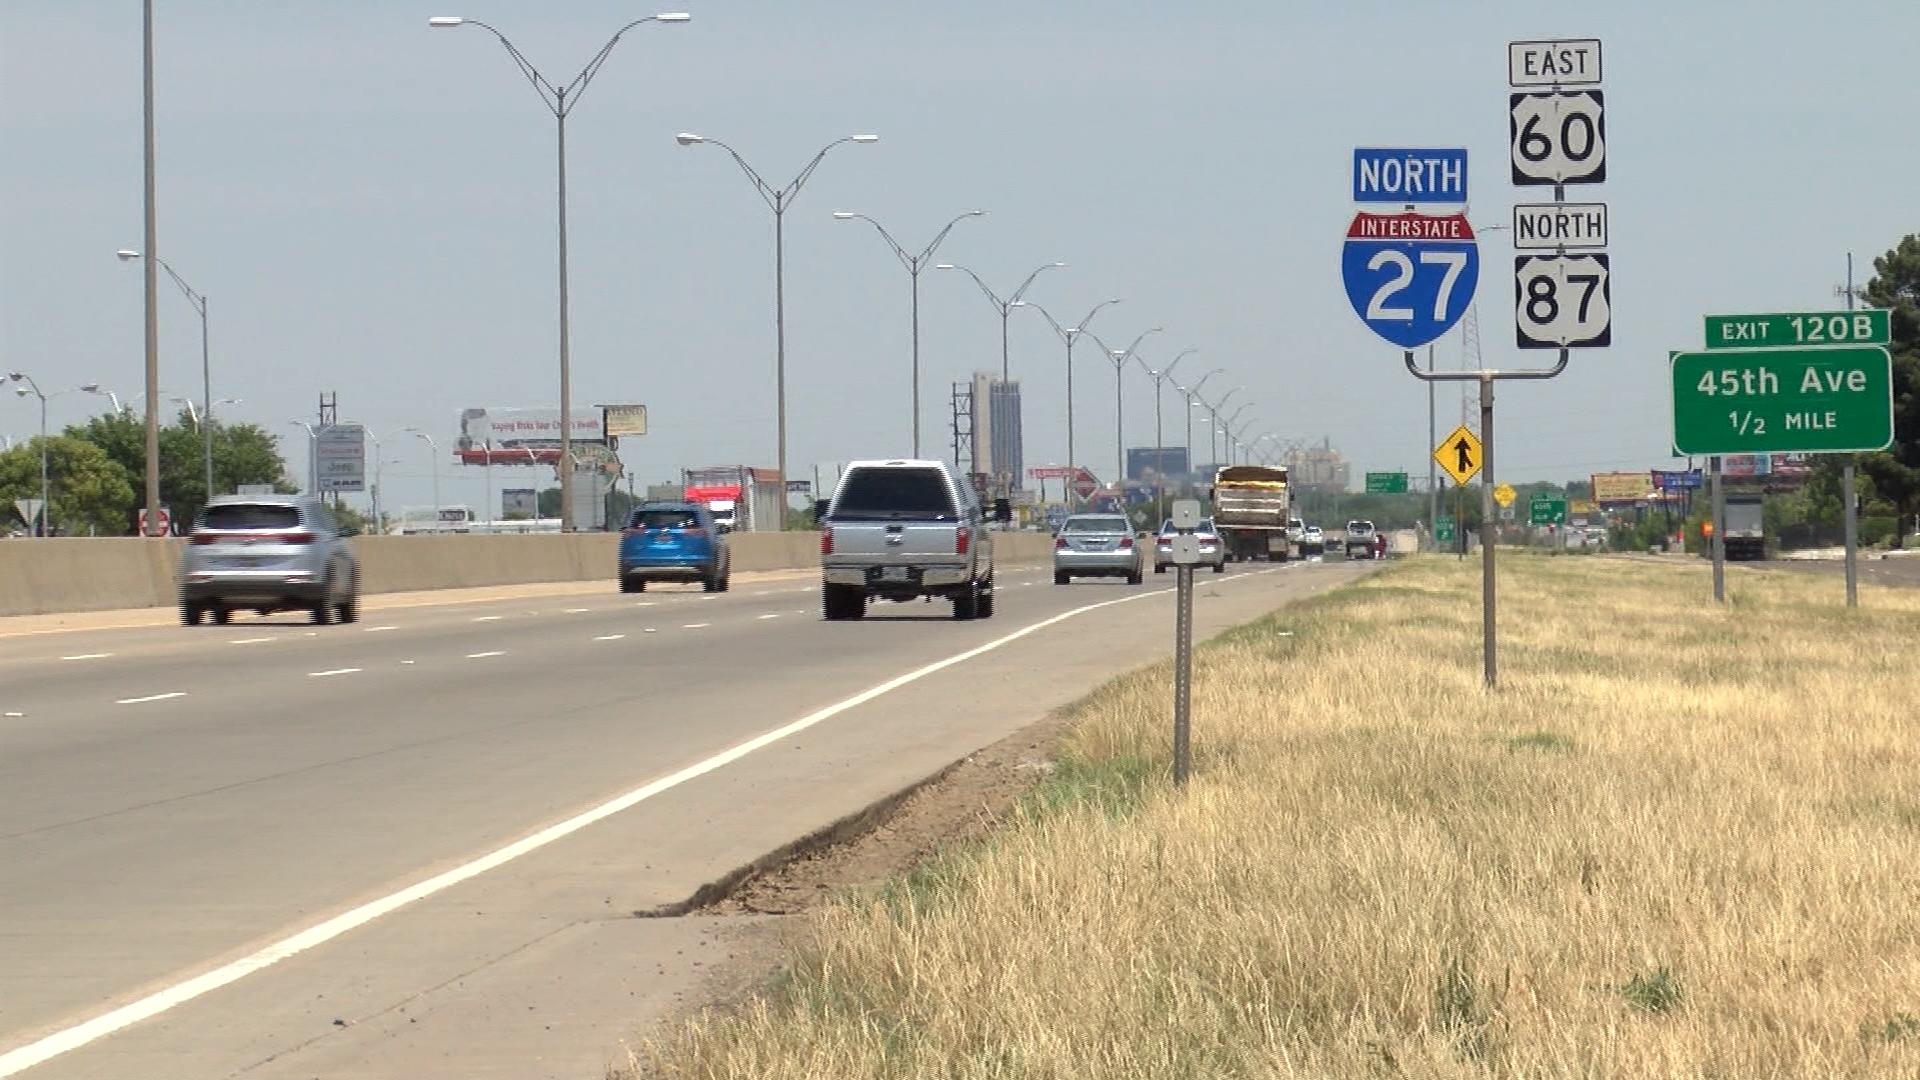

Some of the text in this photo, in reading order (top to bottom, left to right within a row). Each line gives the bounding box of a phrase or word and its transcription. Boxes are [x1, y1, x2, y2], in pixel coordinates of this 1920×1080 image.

[1523, 49, 1588, 76] EAST
[1519, 112, 1595, 162] 60
[1359, 158, 1461, 193] NORTH
[1360, 218, 1460, 238] INTERSTATE
[1519, 213, 1601, 240] NORTH
[1366, 250, 1467, 322] 27
[1526, 274, 1600, 325] 87
[1722, 315, 1873, 342] EXIT 120B
[1697, 367, 1867, 396] 45th Ave
[1729, 410, 1837, 436] 1/2 MILE
